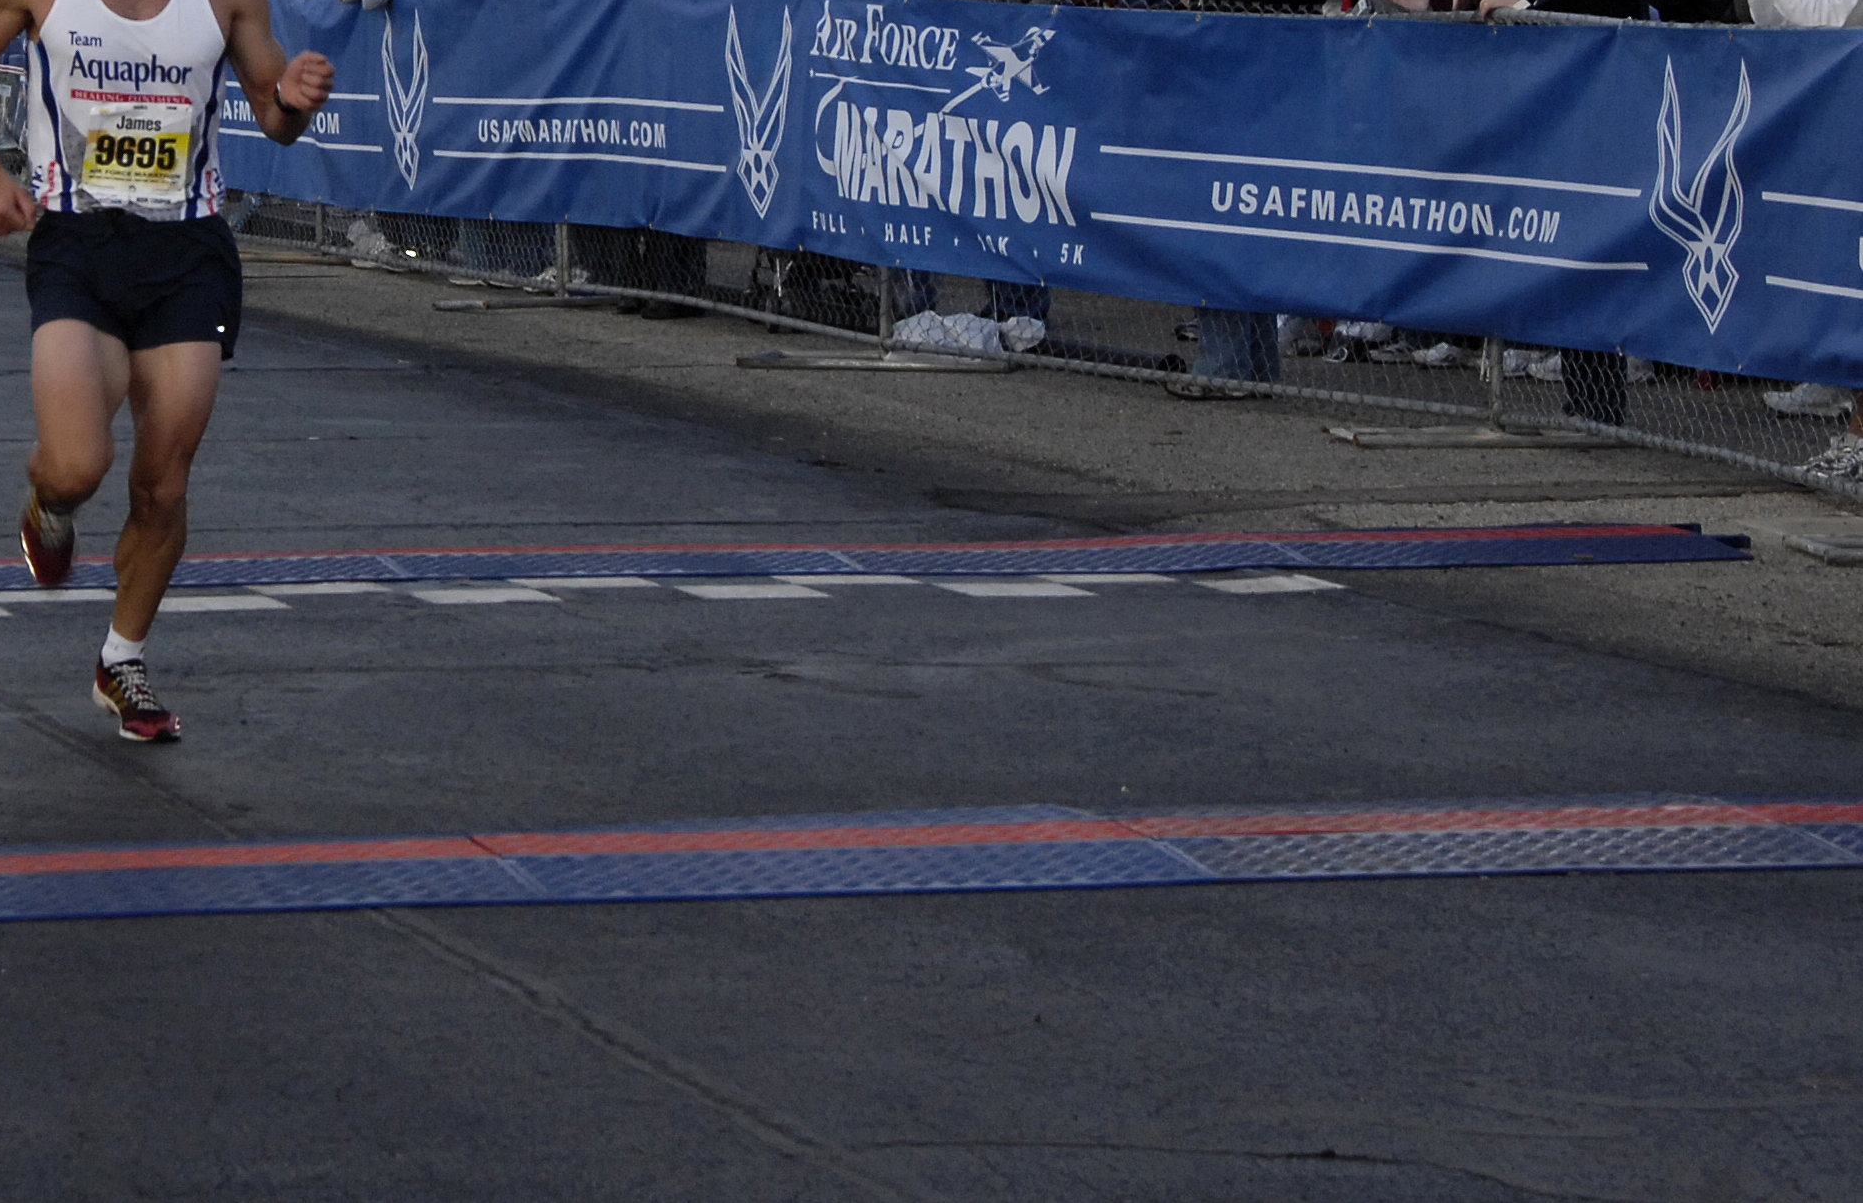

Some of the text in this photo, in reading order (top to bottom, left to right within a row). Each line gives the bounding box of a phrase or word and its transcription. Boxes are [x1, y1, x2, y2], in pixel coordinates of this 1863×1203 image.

[68, 31, 103, 47] Team
[810, 0, 960, 71] AIR FORCE
[69, 49, 193, 92] Aquaphor
[116, 115, 162, 132] James
[478, 117, 667, 150] USAFMARATHON.COM
[94, 134, 178, 171] 9695
[836, 100, 1077, 228] MARATHON
[1210, 181, 1562, 244] USAFMARATHON.COM
[812, 210, 1085, 266] FULL HALF 10K 5K
